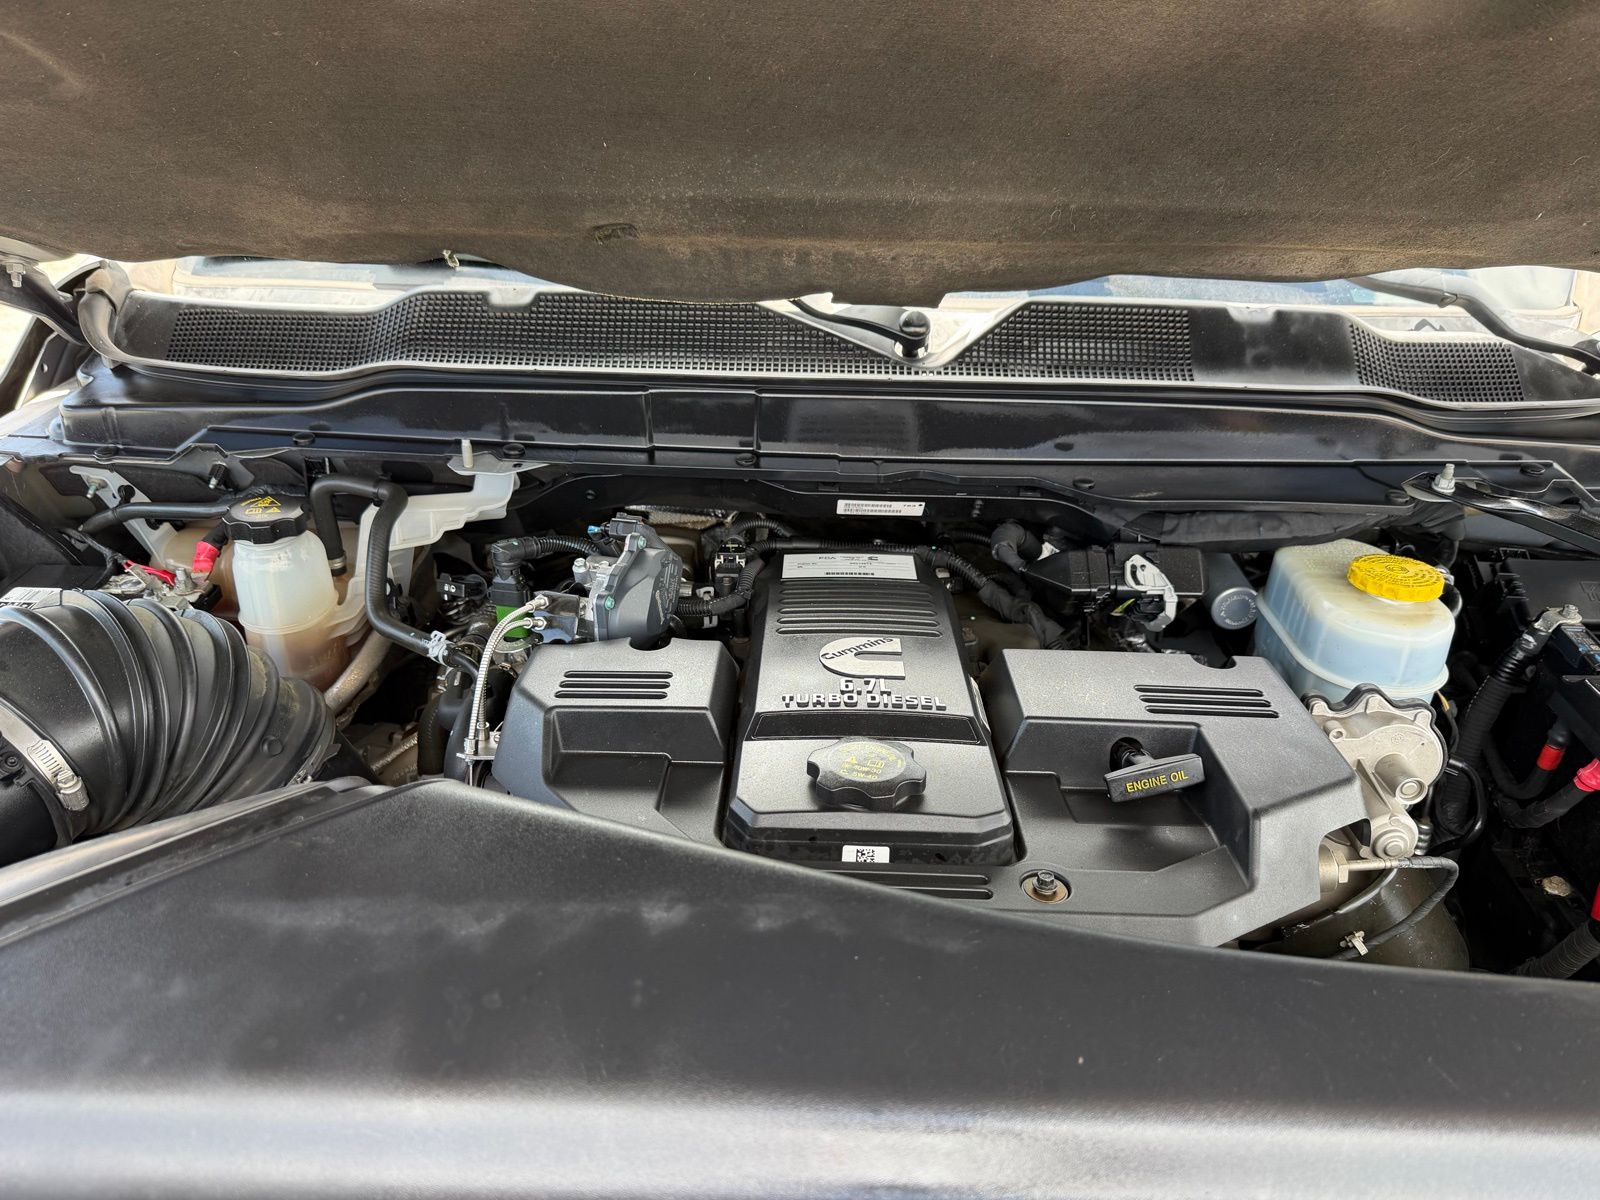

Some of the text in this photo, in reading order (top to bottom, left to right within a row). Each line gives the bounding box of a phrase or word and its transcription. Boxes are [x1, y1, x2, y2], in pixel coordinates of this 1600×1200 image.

[820, 637, 894, 660] Cummins
[840, 678, 891, 695] 6.7L
[782, 693, 947, 711] TURBO DIESEL
[1126, 770, 1189, 793] ENGINE OIL
